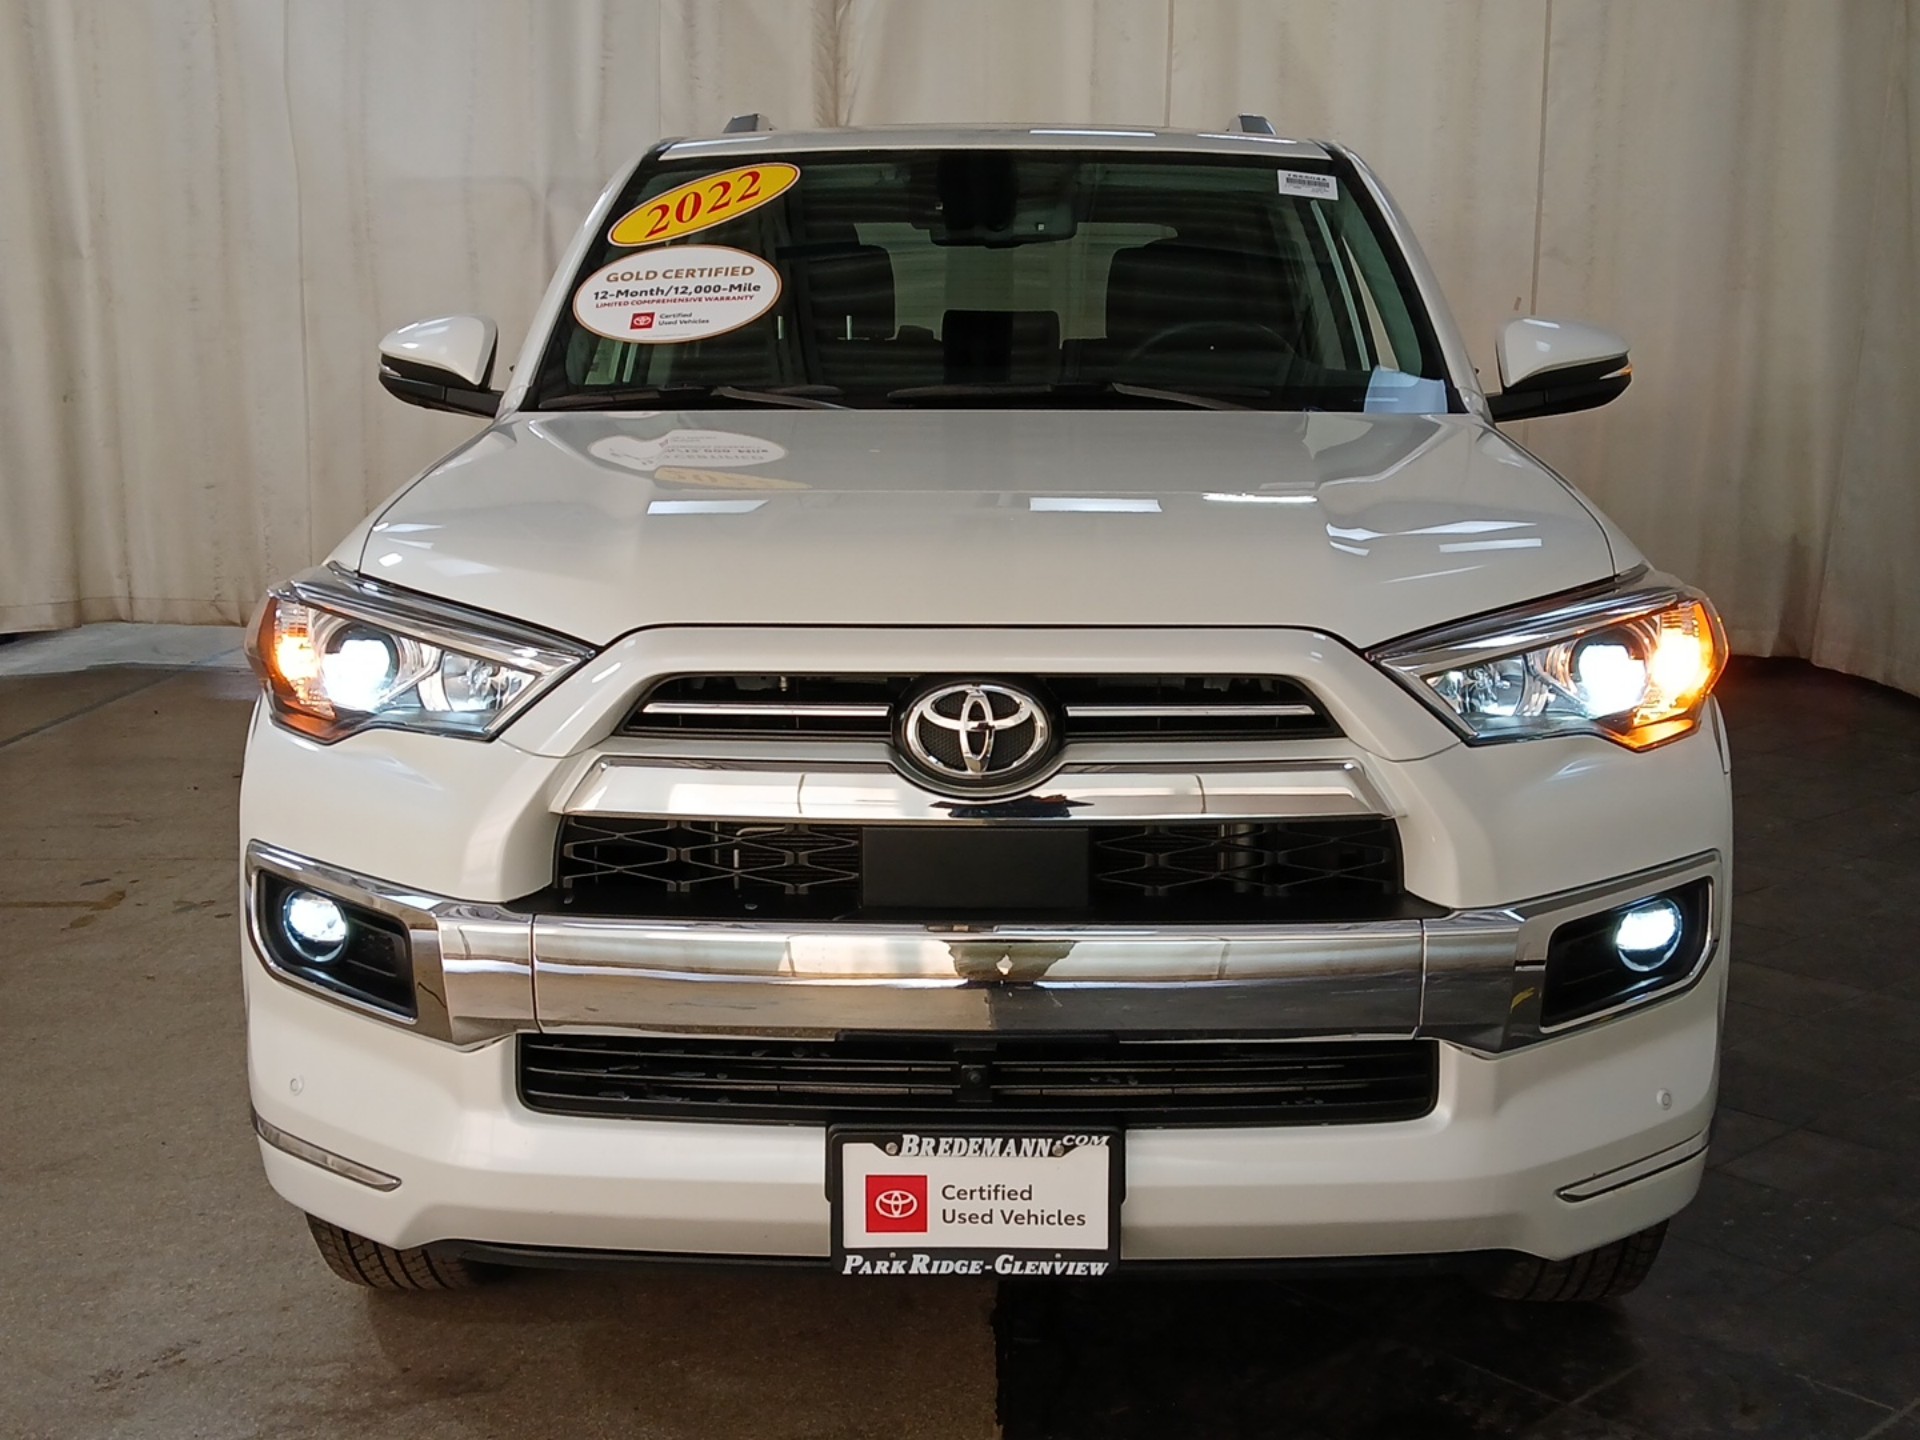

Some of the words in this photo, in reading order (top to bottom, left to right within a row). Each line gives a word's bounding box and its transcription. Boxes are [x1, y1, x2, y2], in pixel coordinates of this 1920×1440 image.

[644, 170, 761, 238] 2022
[606, 270, 658, 283] GOLD
[662, 266, 755, 280] CERTIFIED
[594, 282, 761, 300] 12-Month/12,000-Mile
[595, 300, 629, 309] LIMITED
[631, 297, 703, 307] COMPREHENSIVE
[705, 295, 754, 303] WARRANTY
[941, 1184, 1033, 1201] Certified
[941, 1209, 994, 1225] Used
[1000, 1209, 1087, 1226] Vehicles
[842, 1255, 907, 1275] PARK
